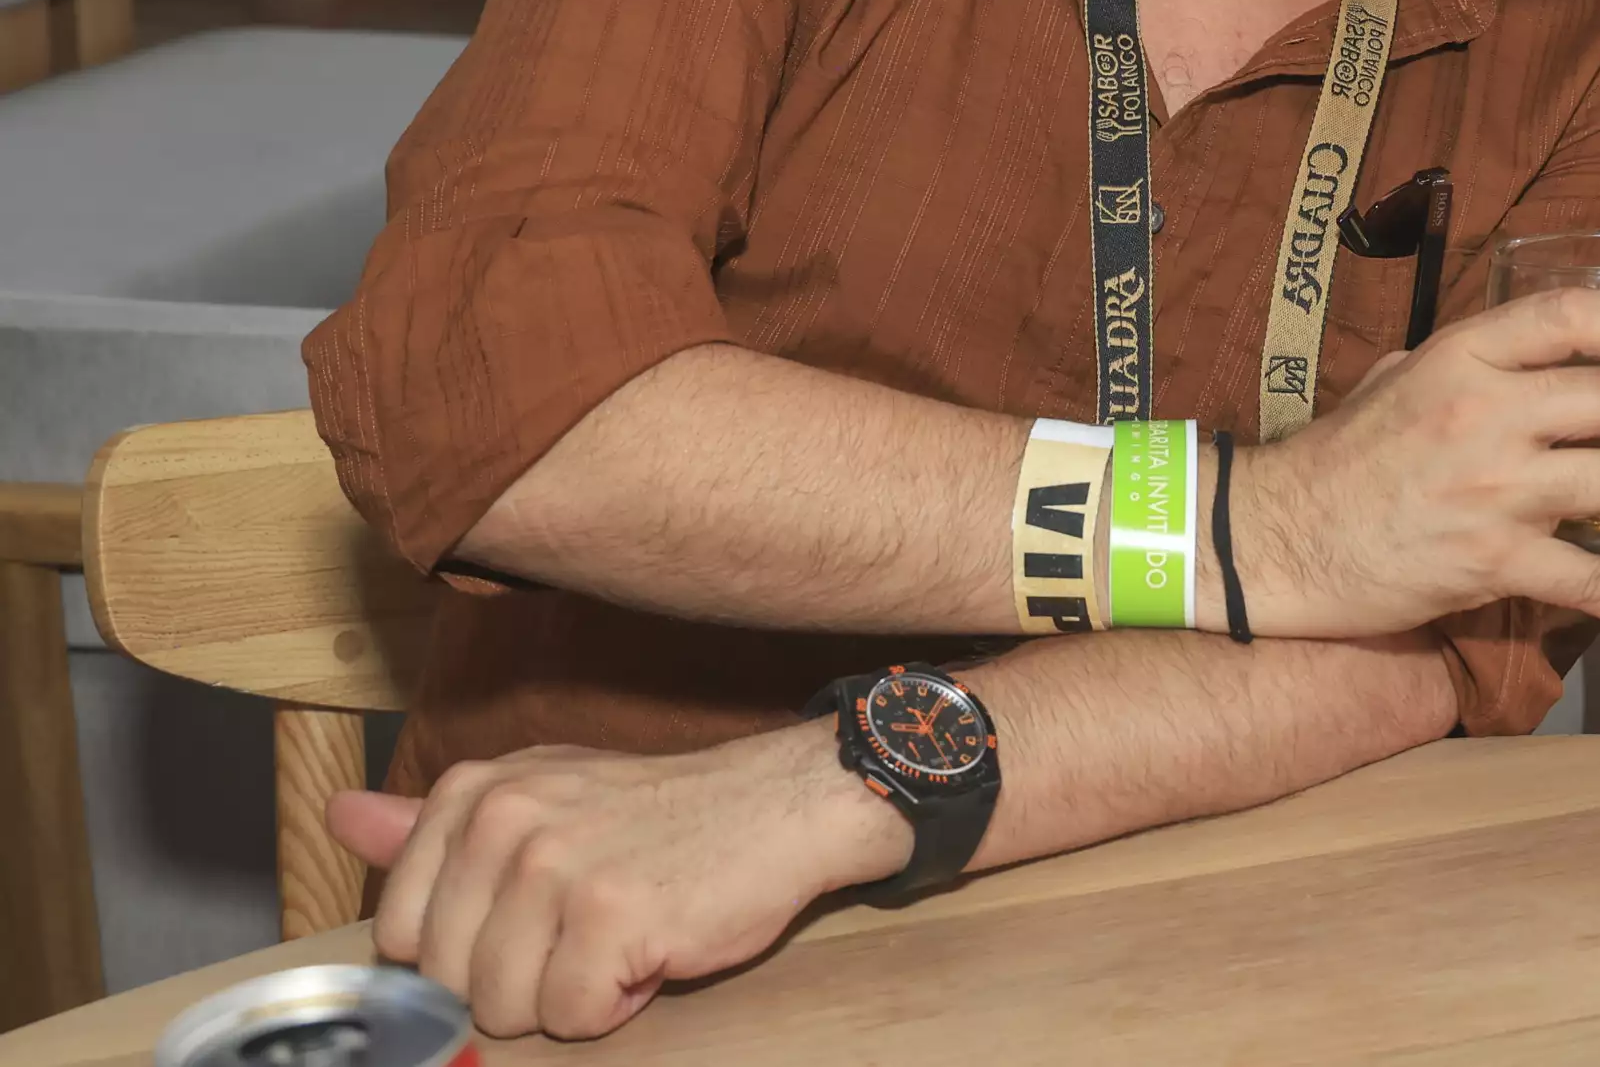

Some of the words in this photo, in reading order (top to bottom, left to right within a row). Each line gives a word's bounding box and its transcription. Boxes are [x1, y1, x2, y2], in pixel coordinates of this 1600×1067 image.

[1094, 33, 1119, 119] SABOR
[1117, 34, 1142, 121] POLANCO
[1435, 192, 1448, 227] BOSS
[1024, 482, 1093, 631] VIP
[1146, 476, 1169, 589] INVITDO
